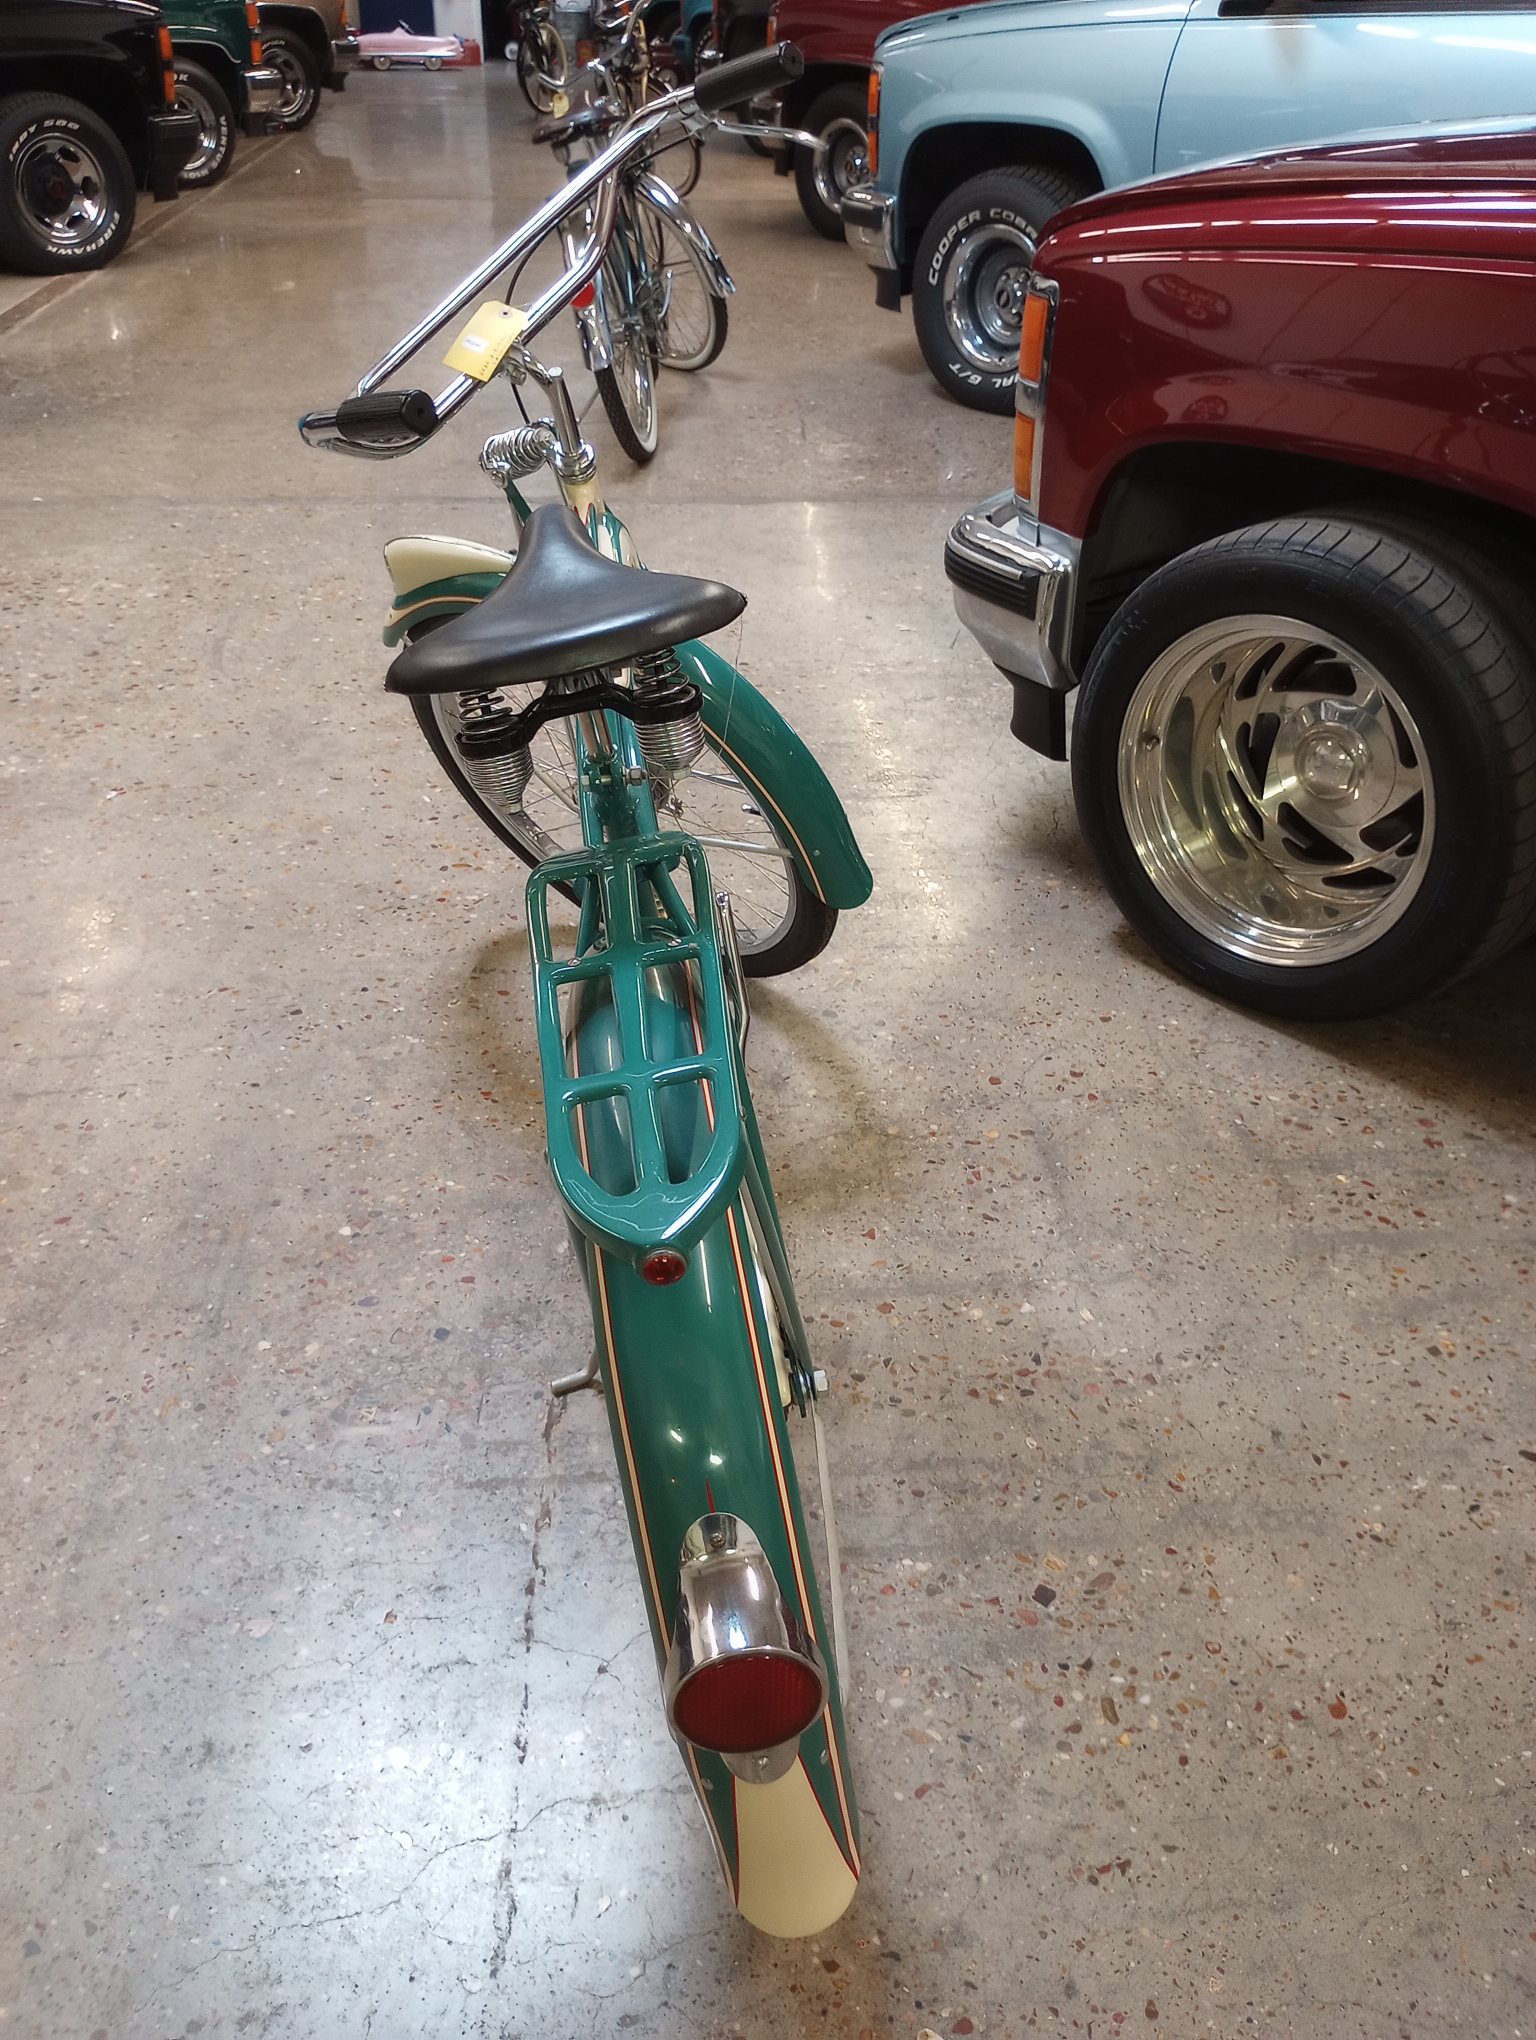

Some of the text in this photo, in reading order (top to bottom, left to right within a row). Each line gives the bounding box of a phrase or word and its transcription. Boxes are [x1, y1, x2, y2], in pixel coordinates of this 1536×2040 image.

[8, 119, 80, 162] INDY 500
[45, 210, 121, 256] FIREHAWK
[928, 207, 1039, 287] COOPER COBR
[948, 363, 983, 386] G/T
